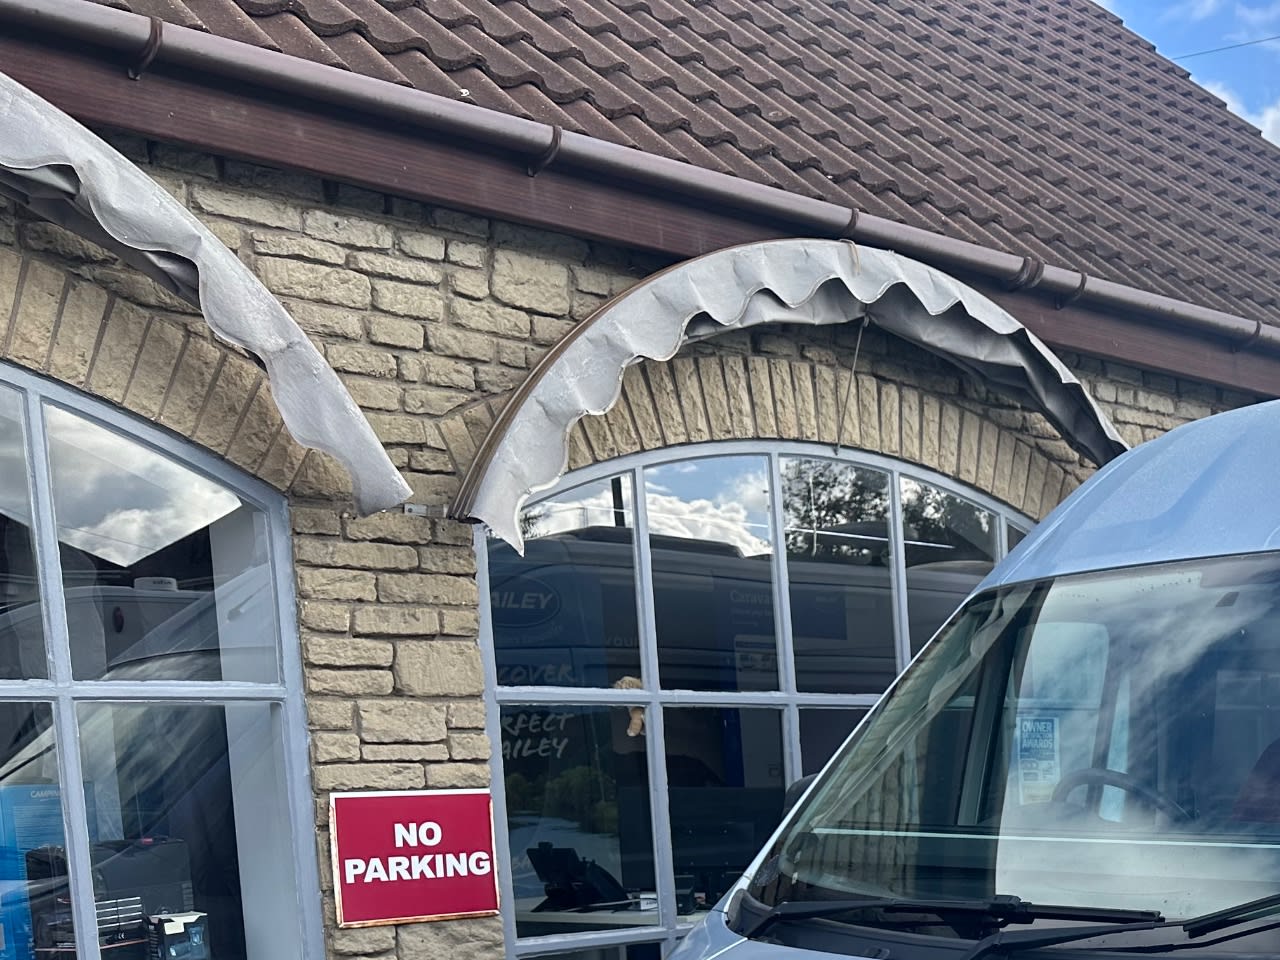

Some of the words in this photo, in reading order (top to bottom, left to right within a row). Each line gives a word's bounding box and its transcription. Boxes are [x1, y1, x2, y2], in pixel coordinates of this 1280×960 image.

[1022, 721, 1053, 733] OWNER
[394, 821, 442, 848] NO
[344, 851, 491, 884] PARKING
